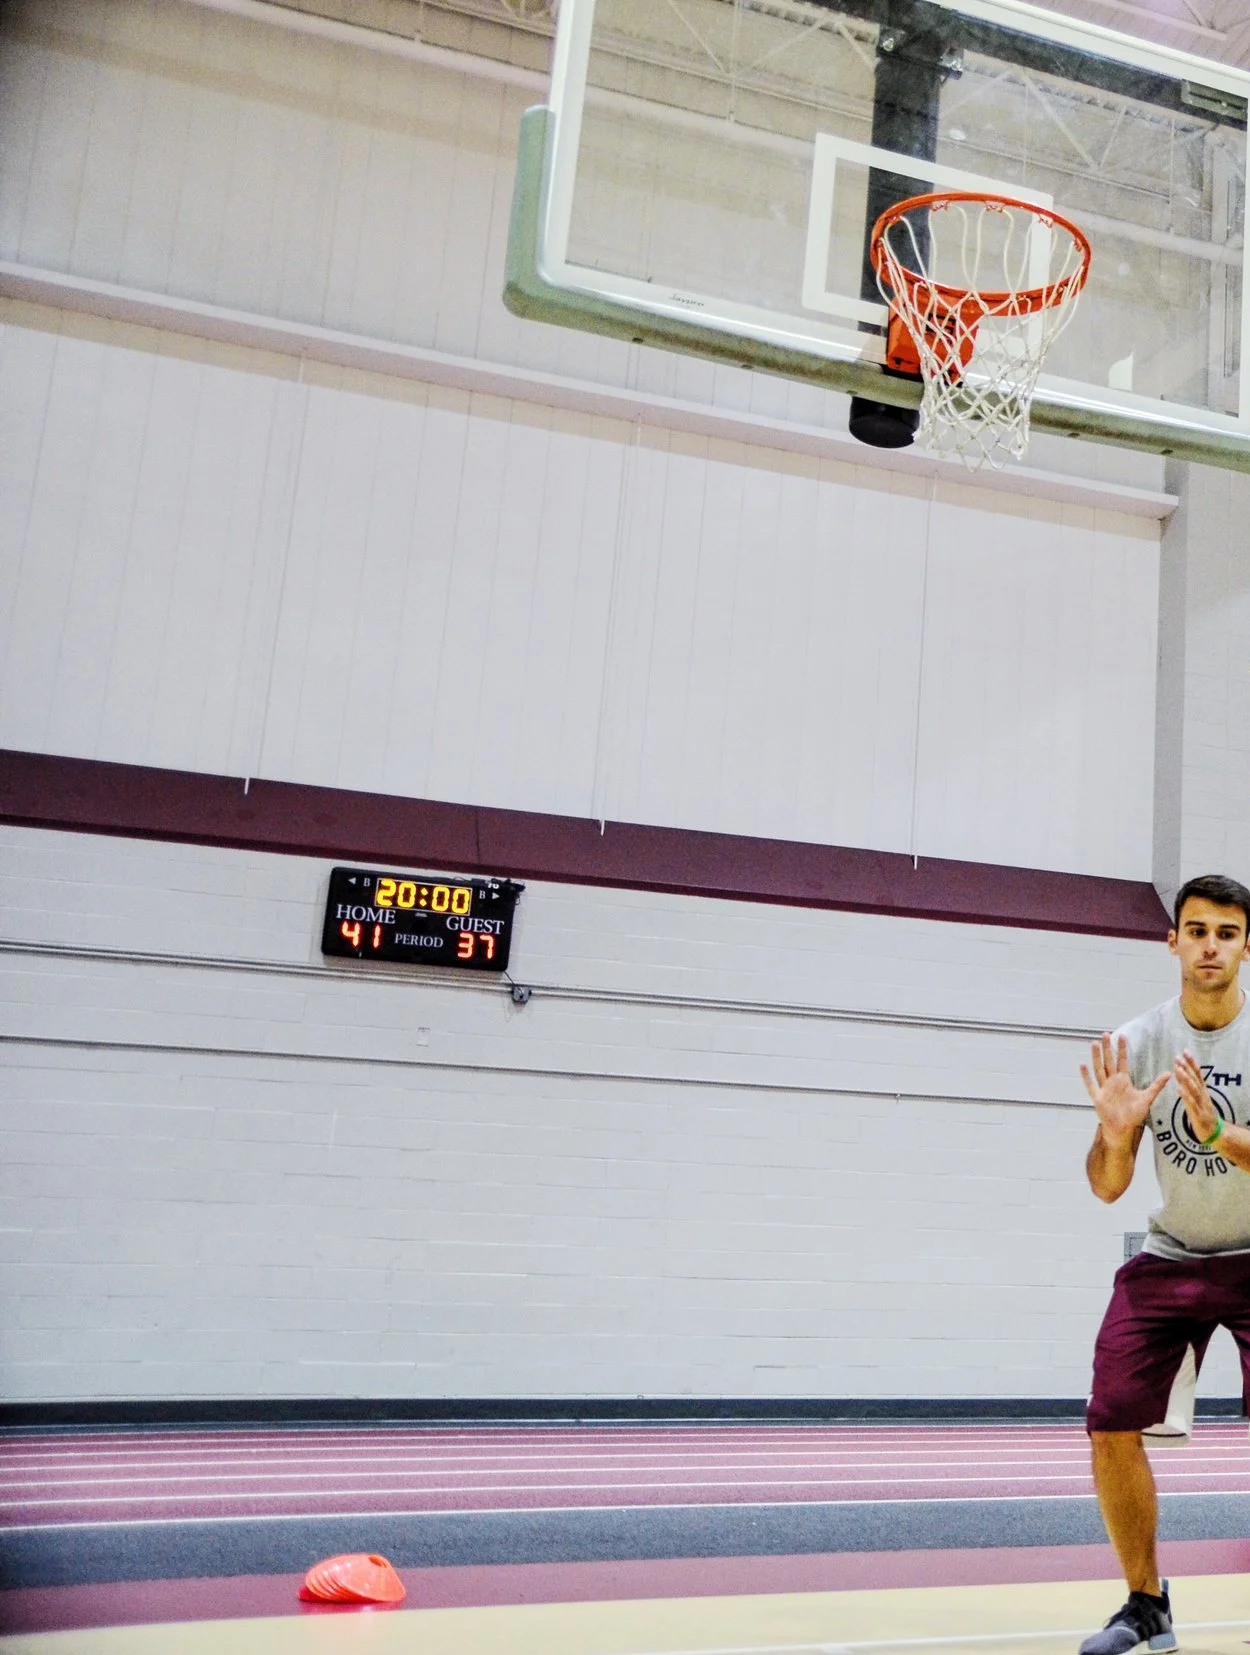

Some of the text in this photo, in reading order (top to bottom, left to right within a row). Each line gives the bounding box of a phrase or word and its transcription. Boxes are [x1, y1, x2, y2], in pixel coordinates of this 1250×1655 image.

[363, 878, 371, 887] B
[376, 878, 472, 915] 20:00
[479, 890, 486, 899] B
[336, 904, 396, 924] HOME
[341, 920, 382, 948] 41
[446, 916, 504, 935] GUEST
[394, 933, 444, 949] PERIOD
[457, 932, 495, 960] 37
[1156, 1130, 1197, 1175] BORO
